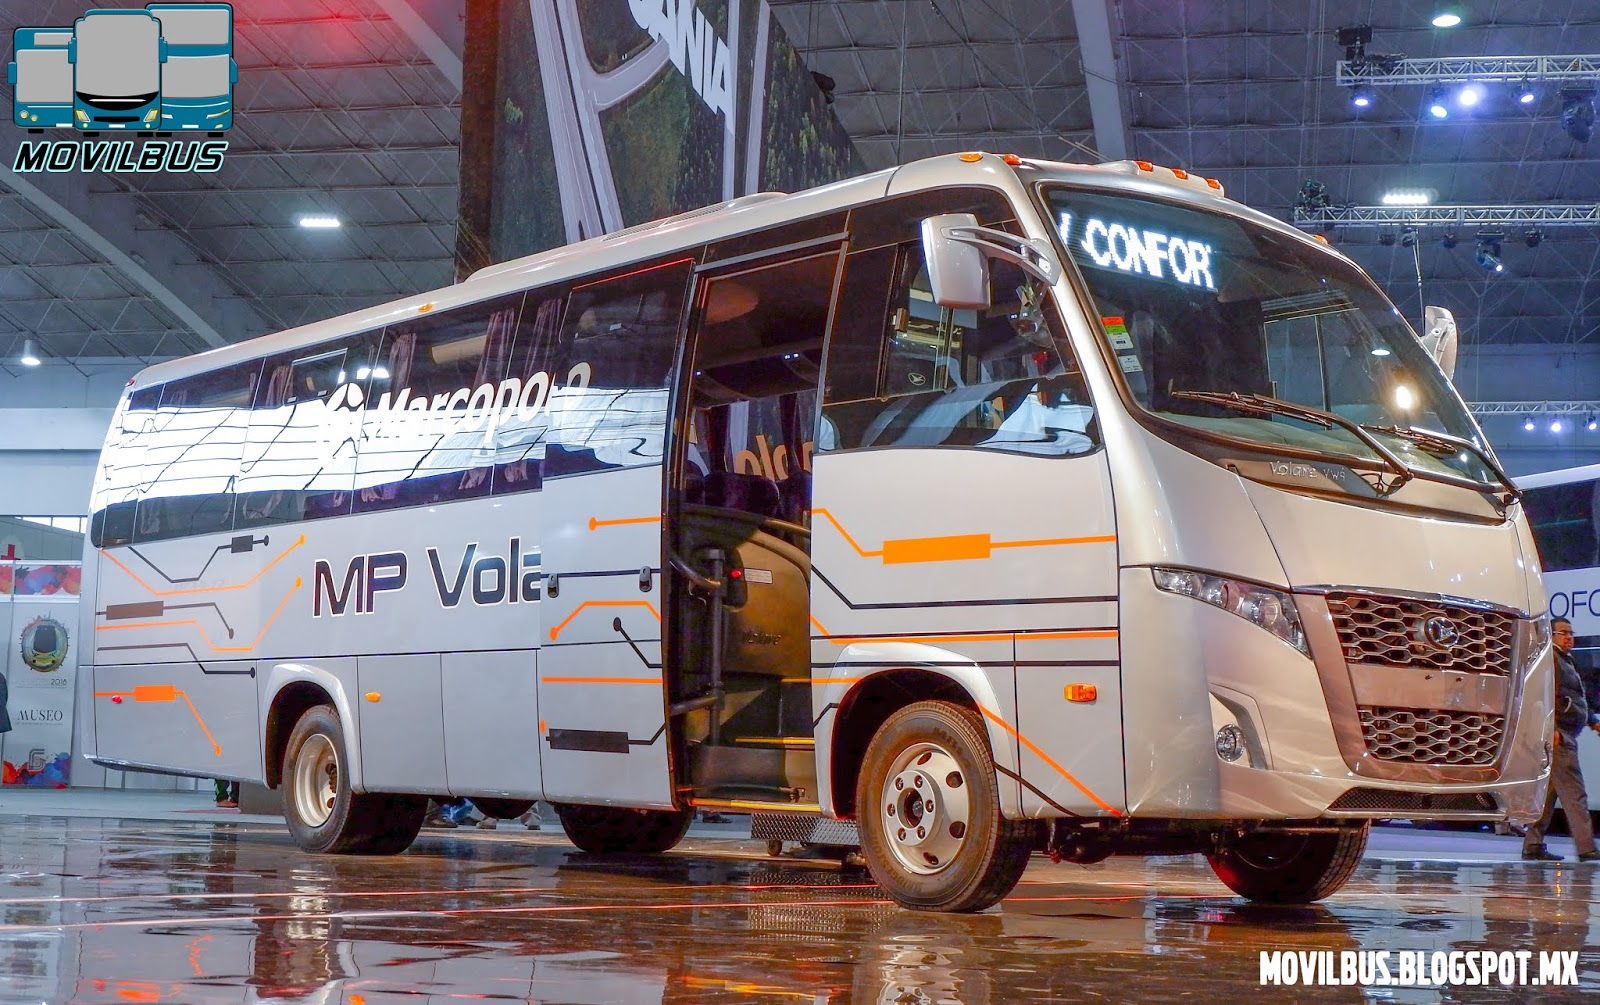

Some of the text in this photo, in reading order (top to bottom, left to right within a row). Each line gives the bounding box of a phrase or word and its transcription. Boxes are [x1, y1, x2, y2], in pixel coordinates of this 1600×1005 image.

[1269, 460, 1317, 478] Volare
[312, 550, 408, 618] MP
[17, 709, 63, 722] MUSEO
